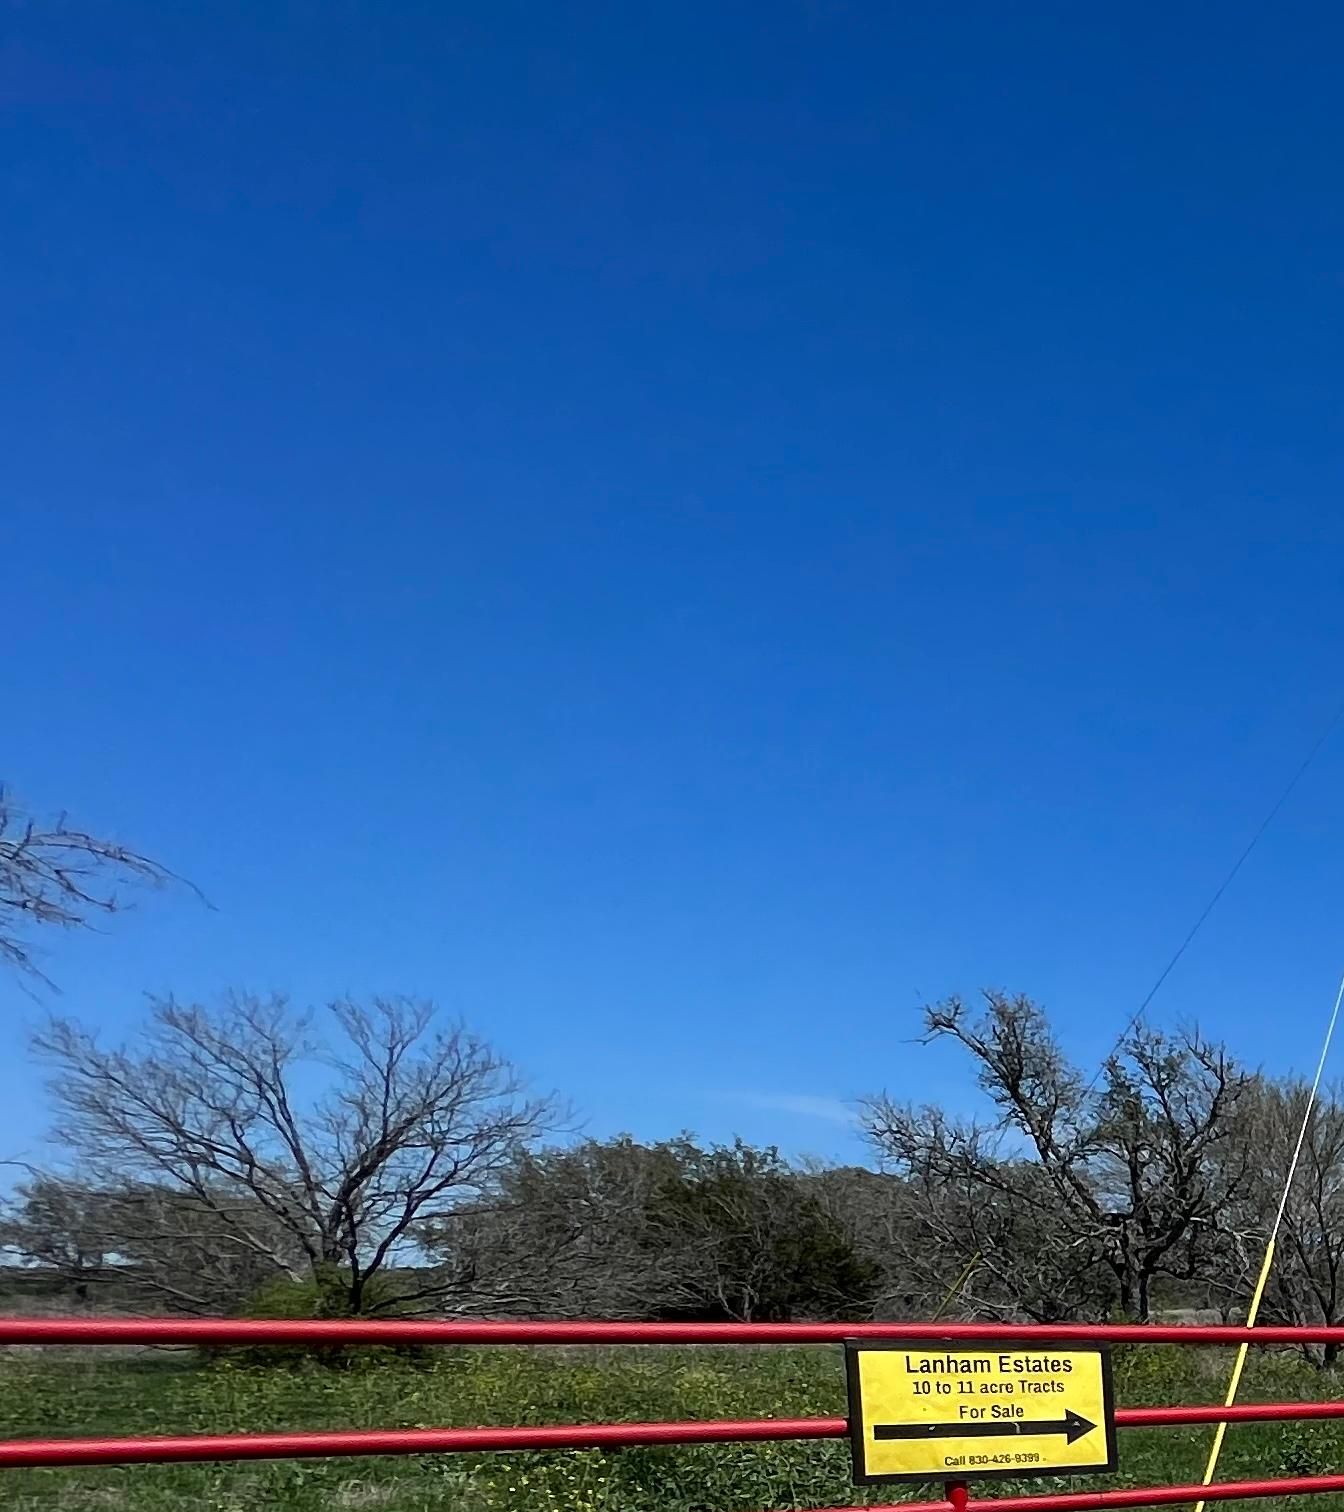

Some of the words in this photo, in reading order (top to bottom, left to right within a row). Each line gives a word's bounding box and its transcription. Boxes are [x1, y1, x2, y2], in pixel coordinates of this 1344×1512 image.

[905, 1355, 991, 1374] Lanham
[999, 1355, 1073, 1373] Estates
[912, 1381, 931, 1395] 10
[935, 1381, 951, 1394] to
[957, 1381, 975, 1394] 11
[979, 1383, 1014, 1394] acre
[1018, 1380, 1065, 1393] Tracts
[959, 1405, 986, 1419] For
[991, 1404, 1024, 1418] Sale
[944, 1455, 966, 1466] Call
